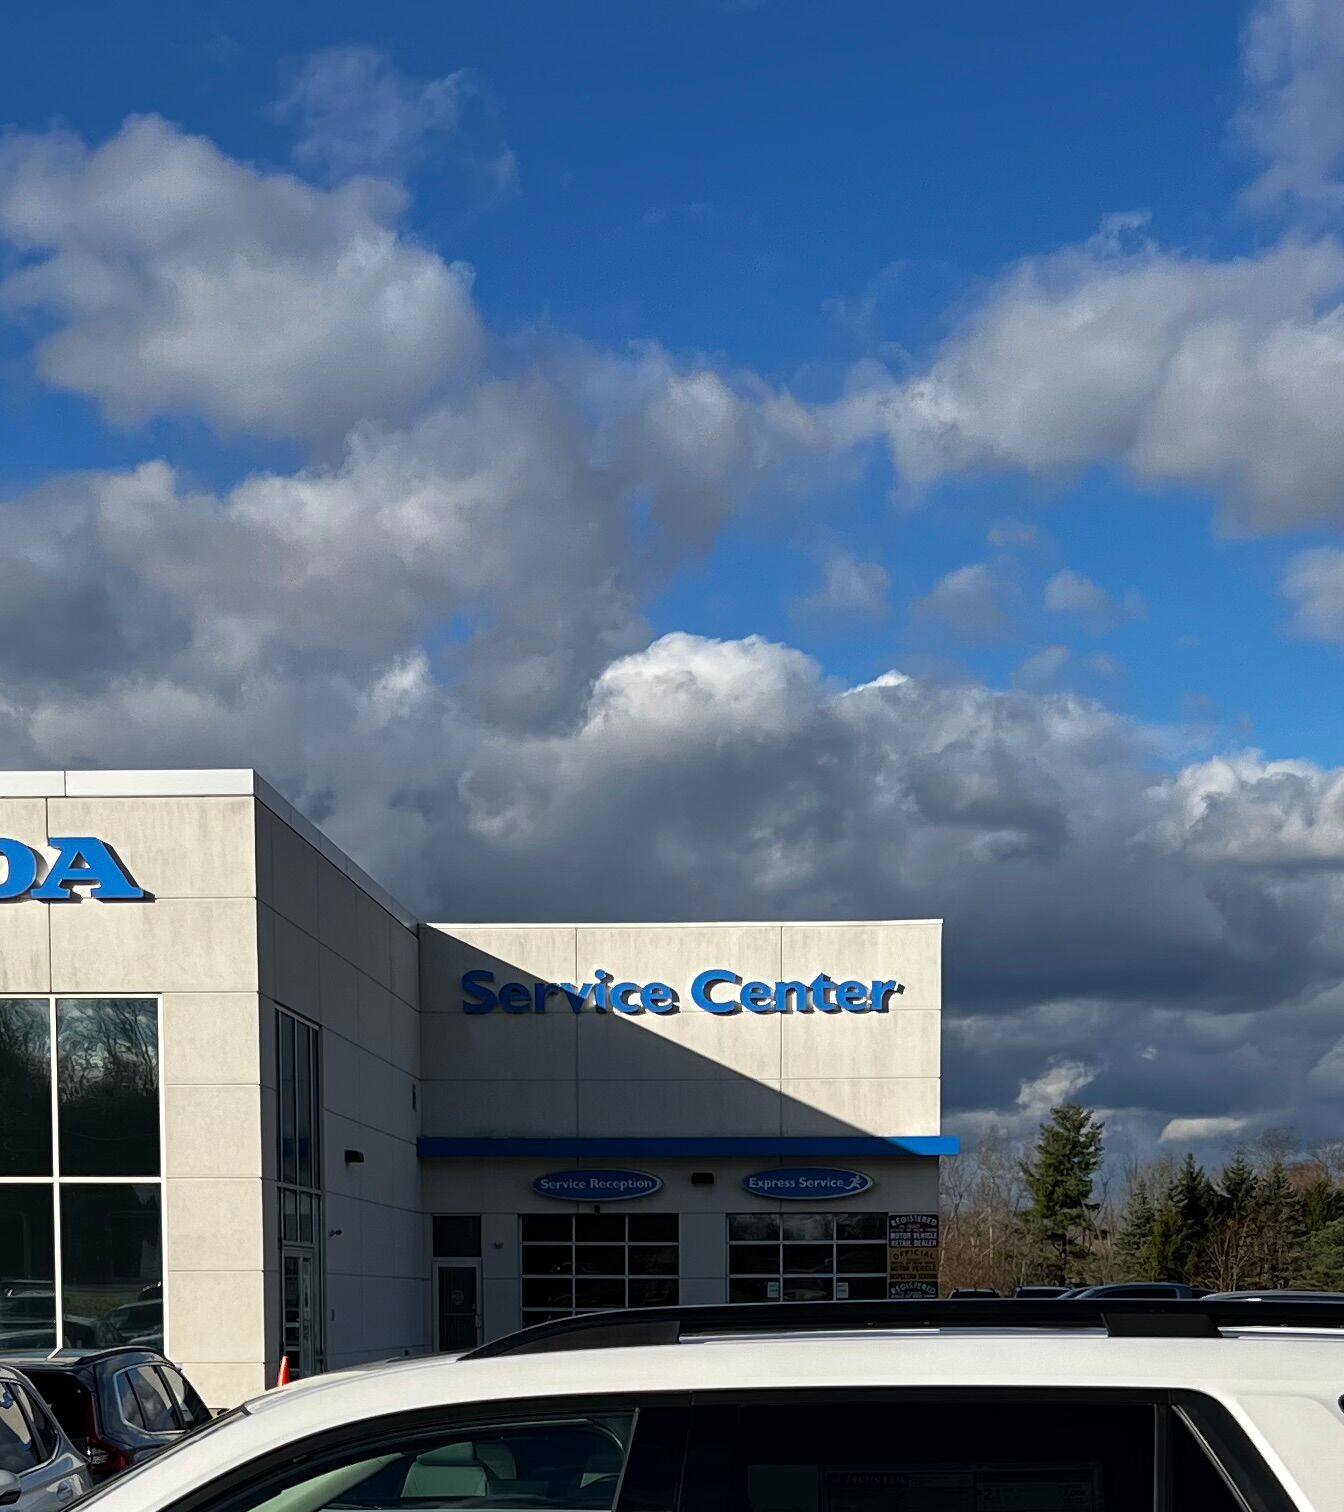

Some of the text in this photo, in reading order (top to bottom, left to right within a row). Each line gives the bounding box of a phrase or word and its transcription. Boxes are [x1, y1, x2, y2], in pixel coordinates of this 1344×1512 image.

[461, 969, 899, 1014] Service Center
[540, 1177, 653, 1192] Service Reception
[748, 1177, 844, 1192] Express Service
[890, 1215, 937, 1226] REGISTERED
[893, 1249, 935, 1260] OFFICIAL
[890, 1282, 936, 1294] REGISTERED
